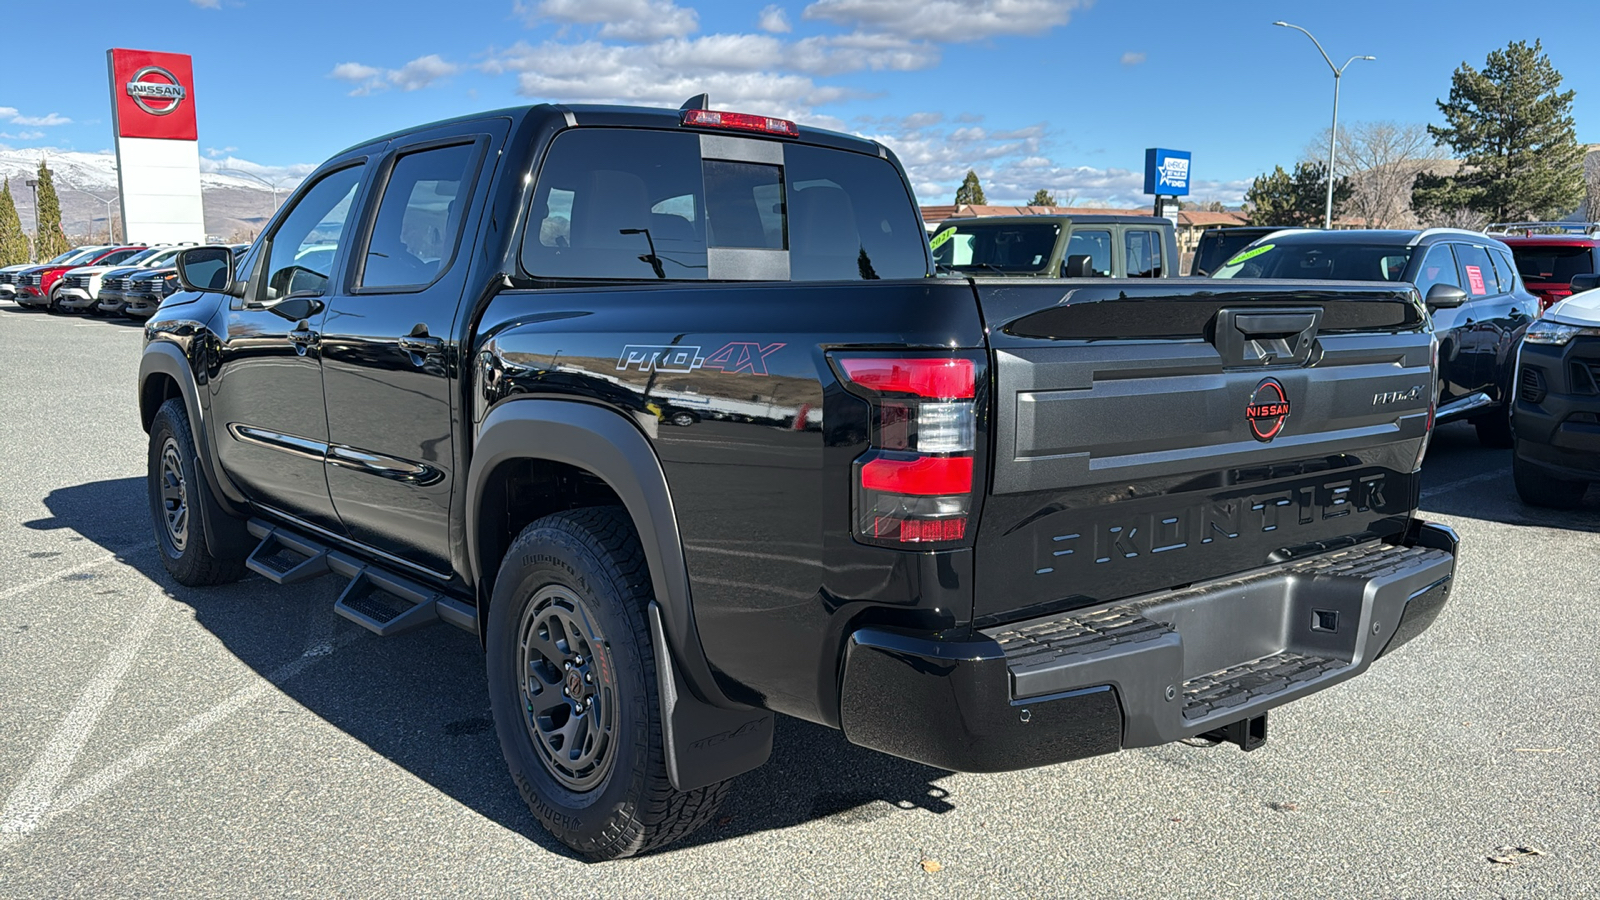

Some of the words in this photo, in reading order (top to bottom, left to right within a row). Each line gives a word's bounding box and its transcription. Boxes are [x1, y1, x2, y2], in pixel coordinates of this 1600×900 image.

[133, 85, 181, 96] NISSAN
[1246, 404, 1289, 417] NISSAN
[1034, 473, 1388, 575] FRONTIER
